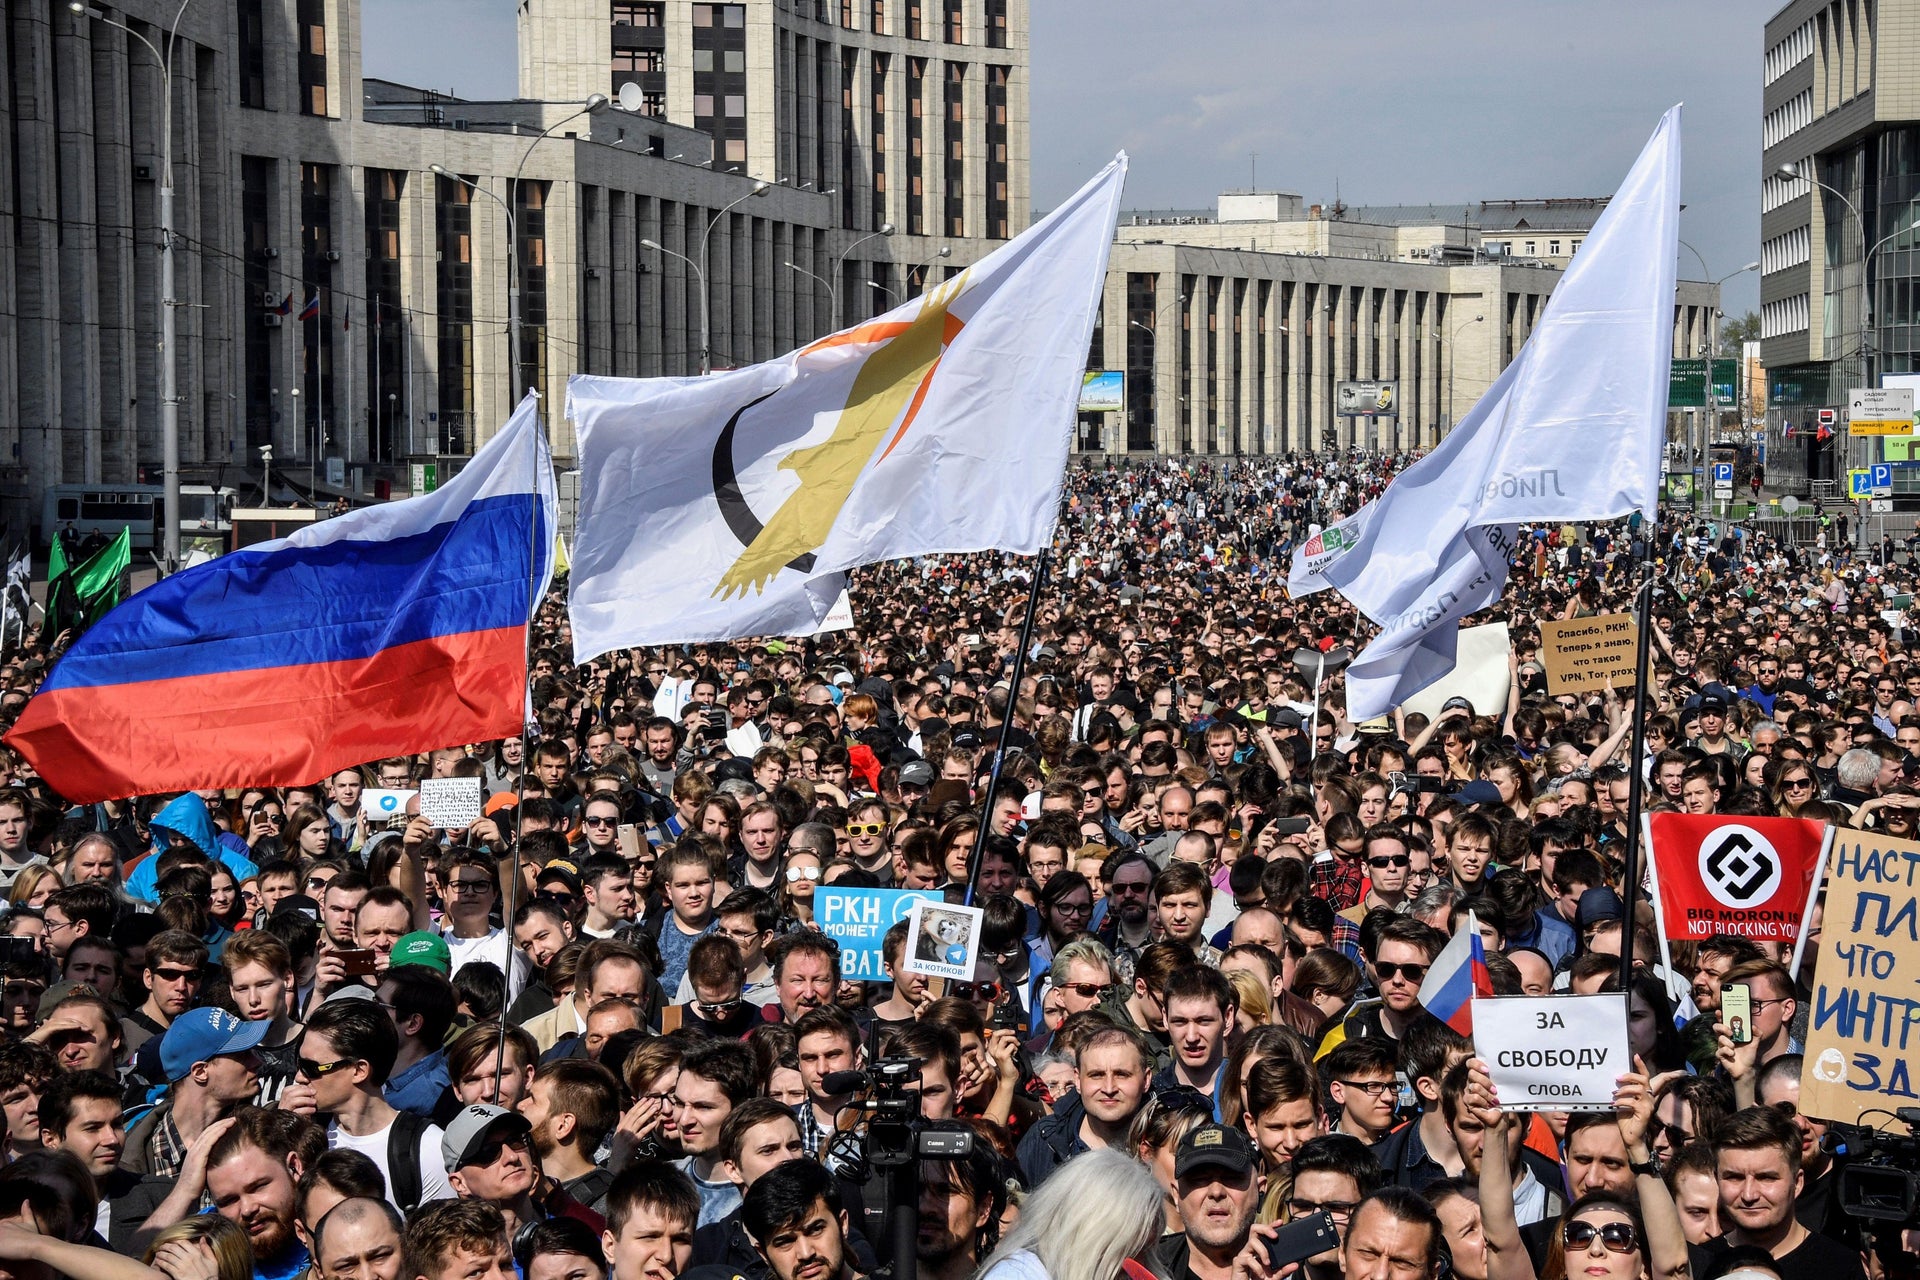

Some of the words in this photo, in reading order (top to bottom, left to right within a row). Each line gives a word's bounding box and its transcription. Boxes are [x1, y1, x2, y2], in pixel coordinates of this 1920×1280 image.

[1557, 626, 1603, 639] Спасибо,
[1605, 622, 1629, 633] РКН!
[1556, 644, 1592, 654] Теперь
[1604, 638, 1634, 648] знаю,
[1573, 658, 1590, 667] что
[1592, 655, 1621, 664] такое
[1560, 673, 1585, 682] VPN,
[1587, 670, 1608, 680] Tor,
[1687, 908, 1715, 919] BIG
[1719, 910, 1784, 921] MORON
[1788, 912, 1798, 923] IS
[824, 924, 879, 938] МОЖЕТ
[1687, 920, 1713, 935] NOT
[1715, 922, 1777, 936] BLOCKING
[1835, 941, 1896, 980] ЧТО
[912, 961, 923, 971] ЗА
[924, 963, 966, 976] КОТИКОВ!
[1536, 1011, 1566, 1030] ЗА
[1497, 1047, 1608, 1070] СВОБОДУ
[1527, 1084, 1583, 1097] СЛОВА
